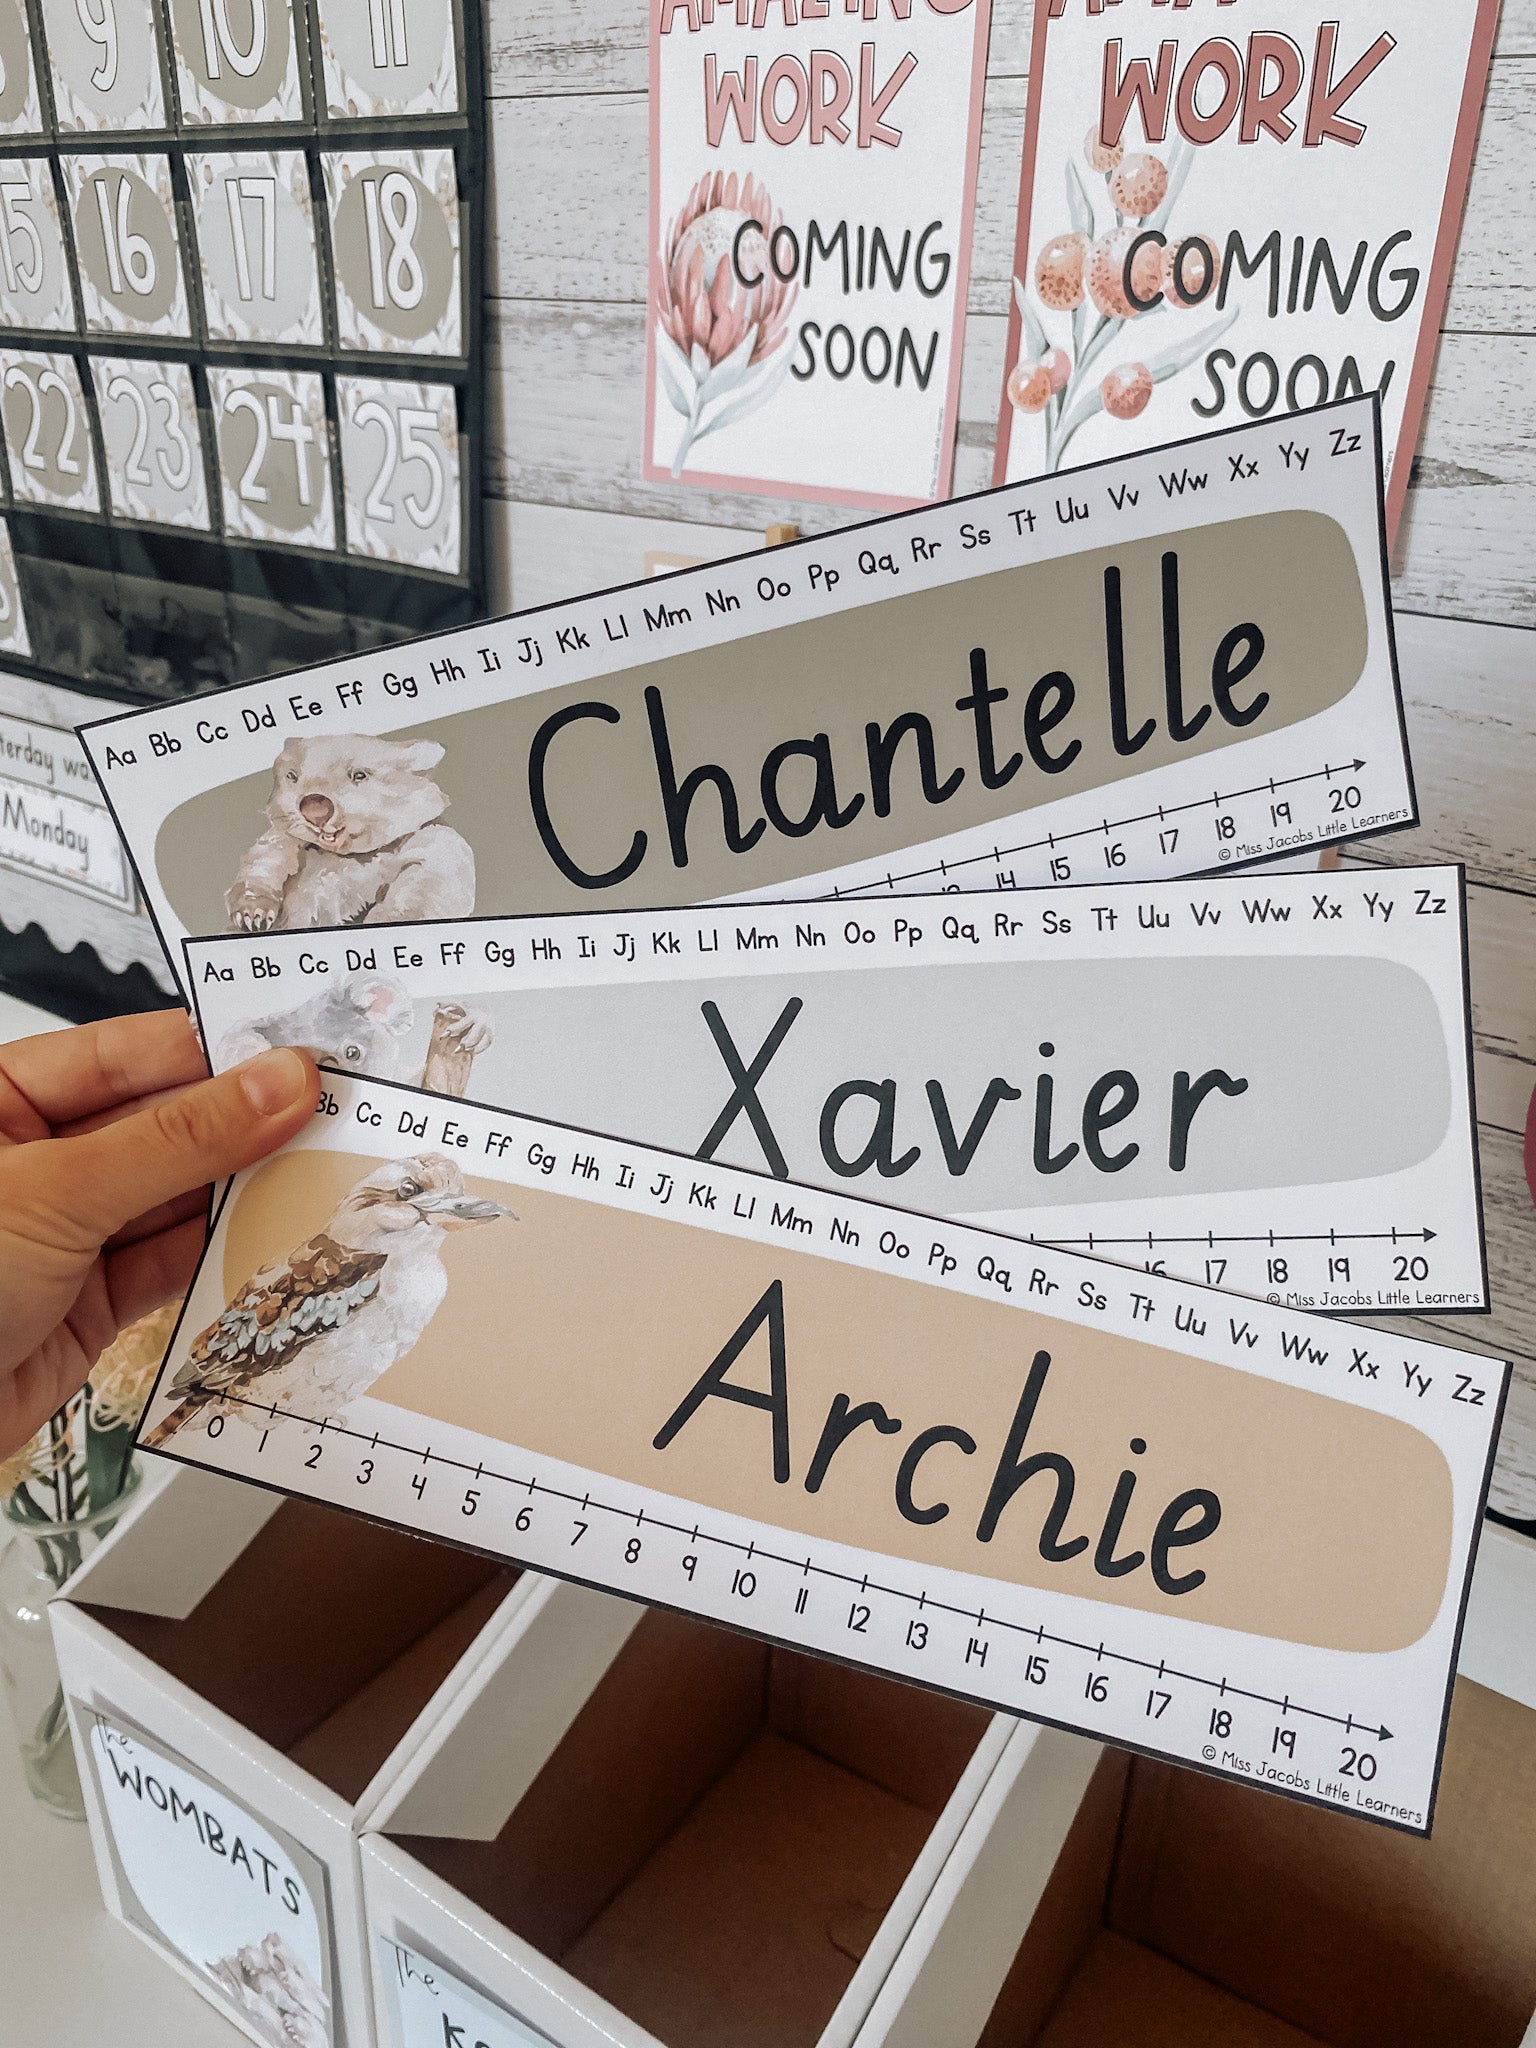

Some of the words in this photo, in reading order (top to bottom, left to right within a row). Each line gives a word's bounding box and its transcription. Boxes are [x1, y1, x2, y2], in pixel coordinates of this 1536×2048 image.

[703, 42, 919, 149] WORK
[1098, 21, 1397, 149] WORK
[94, 175, 156, 296] 16
[224, 176, 276, 301] 17
[361, 171, 424, 310] 18
[732, 217, 951, 298] COMING
[1122, 229, 1418, 322] COMING
[790, 321, 939, 391] SOON
[4, 366, 80, 476] 22
[107, 374, 192, 492] 23
[223, 389, 314, 506] 24
[352, 400, 444, 530] 25
[105, 746, 138, 770] Aa
[148, 730, 182, 758] Bb
[196, 720, 229, 744] Cc
[241, 703, 277, 733] Dd
[288, 695, 324, 721] Ee
[335, 680, 363, 709] Ff
[382, 672, 419, 699] Gg
[429, 657, 466, 686] Hh
[476, 648, 502, 674] Ii
[517, 637, 543, 668] Jj
[555, 626, 591, 654] Kk
[602, 614, 630, 642] Ll
[642, 603, 692, 632] Mm
[705, 588, 741, 616] Nn
[756, 577, 792, 602] Oo
[807, 563, 840, 592] Pp
[857, 550, 900, 575] Qq
[910, 536, 942, 563] Rr
[959, 523, 992, 550] Ss
[1007, 508, 1037, 537] Tt
[1055, 496, 1090, 524] Uu
[1106, 483, 1140, 511] Vv
[1158, 468, 1209, 498] Ww
[1227, 453, 1260, 482] Xx
[1278, 441, 1310, 472] Yy
[1328, 428, 1362, 459] Zz
[528, 551, 1271, 889] Chantelle
[63, 756, 97, 783] wa
[2, 791, 89, 872] Monday
[1049, 856, 1071, 882] 15
[1103, 842, 1127, 869] 16
[1158, 828, 1179, 855] 17
[1214, 815, 1236, 841] 18
[1270, 801, 1292, 828] 19
[1328, 785, 1362, 814] 20
[1236, 844, 1262, 858] Miss
[1266, 829, 1313, 850] Jacobs
[1317, 819, 1348, 837] Little
[1351, 808, 1409, 829] Learners
[203, 961, 235, 984] Aa
[250, 956, 282, 979] Bb
[298, 952, 329, 975] Cc
[345, 947, 377, 972] Dd
[393, 945, 424, 969] Ee
[440, 942, 466, 966] Ff
[484, 940, 515, 968] Gg
[531, 937, 562, 961] Hh
[577, 935, 596, 958] Ii
[613, 933, 635, 962] Jj
[652, 931, 681, 955] Kk
[697, 928, 718, 952] Ll
[735, 926, 779, 951] Mm
[795, 923, 826, 948] Nn
[844, 921, 876, 945] Oo
[894, 918, 923, 948] Pp
[942, 915, 980, 945] Qq
[994, 912, 1024, 937] Rr
[1042, 910, 1072, 935] Ss
[1090, 907, 1118, 932] Tt
[1138, 904, 1170, 929] Uu
[1189, 902, 1222, 927] Vv
[1241, 898, 1291, 924] Ww
[1312, 894, 1343, 920] Xx
[1362, 892, 1394, 923] Yy
[1413, 889, 1447, 915] Zz
[695, 996, 1249, 1179] Xavier
[314, 1090, 340, 1116] Bb
[356, 1101, 382, 1127] Cc
[397, 1110, 429, 1138] Dd
[441, 1121, 469, 1148] Ee
[484, 1131, 513, 1158] Ff
[527, 1143, 557, 1175] Gg
[571, 1153, 600, 1182] Hh
[615, 1164, 634, 1189] Ii
[649, 1173, 673, 1204] Jj
[688, 1182, 718, 1210] Kk
[733, 1193, 756, 1220] Ll
[770, 1202, 813, 1235] Mm
[829, 1217, 860, 1247] Nn
[879, 1230, 910, 1259] Oo
[928, 1242, 957, 1276] Pp
[977, 1255, 1013, 1293] Qq
[1028, 1268, 1060, 1296] Rr
[1077, 1281, 1108, 1311] Ss
[1129, 1292, 1156, 1322] Tt
[1174, 1304, 1207, 1337] Uu
[1229, 1318, 1259, 1348] Vv
[1281, 1331, 1329, 1366] Ww
[1347, 1348, 1380, 1380] Xx
[1403, 1361, 1433, 1398] Yy
[1451, 1373, 1486, 1406] Zz
[1205, 1259, 1227, 1285] 17
[1267, 1258, 1289, 1284] 18
[1328, 1257, 1351, 1283] 19
[1392, 1255, 1429, 1282] 20
[1286, 1292, 1314, 1307] Miss
[1320, 1290, 1371, 1305] Jacobs
[1377, 1289, 1409, 1304] Little
[1415, 1289, 1480, 1303] Learners
[653, 1279, 1221, 1595] Archie
[206, 1414, 225, 1439] 0
[303, 1444, 323, 1470] 2
[356, 1459, 375, 1485] 3
[411, 1473, 428, 1501] 4
[461, 1489, 481, 1516] 5
[515, 1506, 534, 1532] 6
[570, 1520, 589, 1546] 7
[624, 1537, 642, 1564] 8
[682, 1555, 698, 1582] 9
[731, 1569, 757, 1598] 10
[794, 1587, 809, 1615] 11
[847, 1603, 871, 1633] 12
[905, 1620, 929, 1650] 13
[965, 1637, 989, 1668] 14
[1024, 1654, 1050, 1685] 15
[1084, 1672, 1109, 1703] 16
[1145, 1689, 1172, 1719] 17
[1209, 1707, 1233, 1739] 18
[1271, 1726, 1297, 1759] 19
[1337, 1746, 1378, 1782] 20
[82, 1706, 133, 1754] The
[107, 1748, 302, 1916] WOMBATS
[1222, 1751, 1251, 1772] Miss
[1256, 1761, 1310, 1790] Jacobs
[1317, 1778, 1349, 1801] Little
[1357, 1790, 1421, 1823] Learners
[381, 1935, 439, 1995] The
